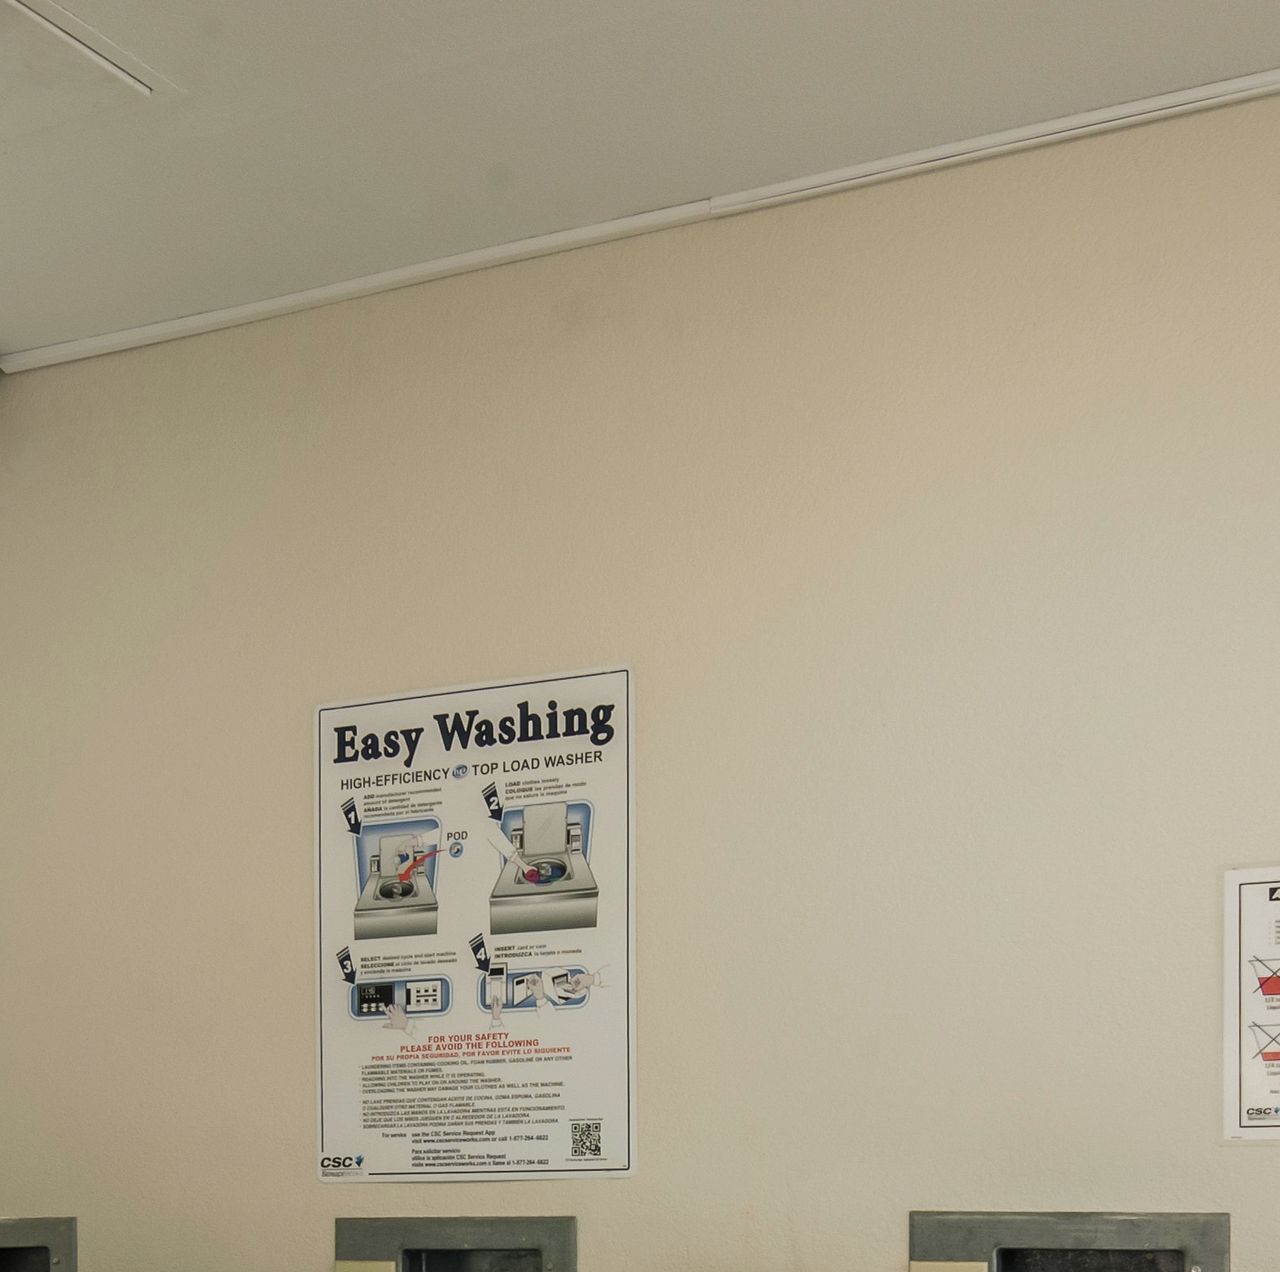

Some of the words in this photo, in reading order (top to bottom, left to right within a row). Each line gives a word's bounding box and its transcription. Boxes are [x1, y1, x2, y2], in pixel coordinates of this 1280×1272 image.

[333, 725, 424, 768] Easy
[433, 700, 615, 751] Washing
[340, 768, 449, 790] HIGH-EFFICIENCY
[472, 763, 498, 775] TOP
[503, 758, 540, 773] LOAD
[544, 750, 602, 768] WASHER
[447, 831, 468, 841] POD
[448, 1034, 472, 1042] YOUR
[475, 1032, 509, 1041] SAFETY
[400, 1044, 432, 1052] PLEASE
[436, 1043, 463, 1051] AVOID
[466, 1041, 483, 1049] THE
[486, 1039, 539, 1048] FOLLOWING
[1247, 1108, 1271, 1116] CSC
[321, 1157, 353, 1168] CSC
